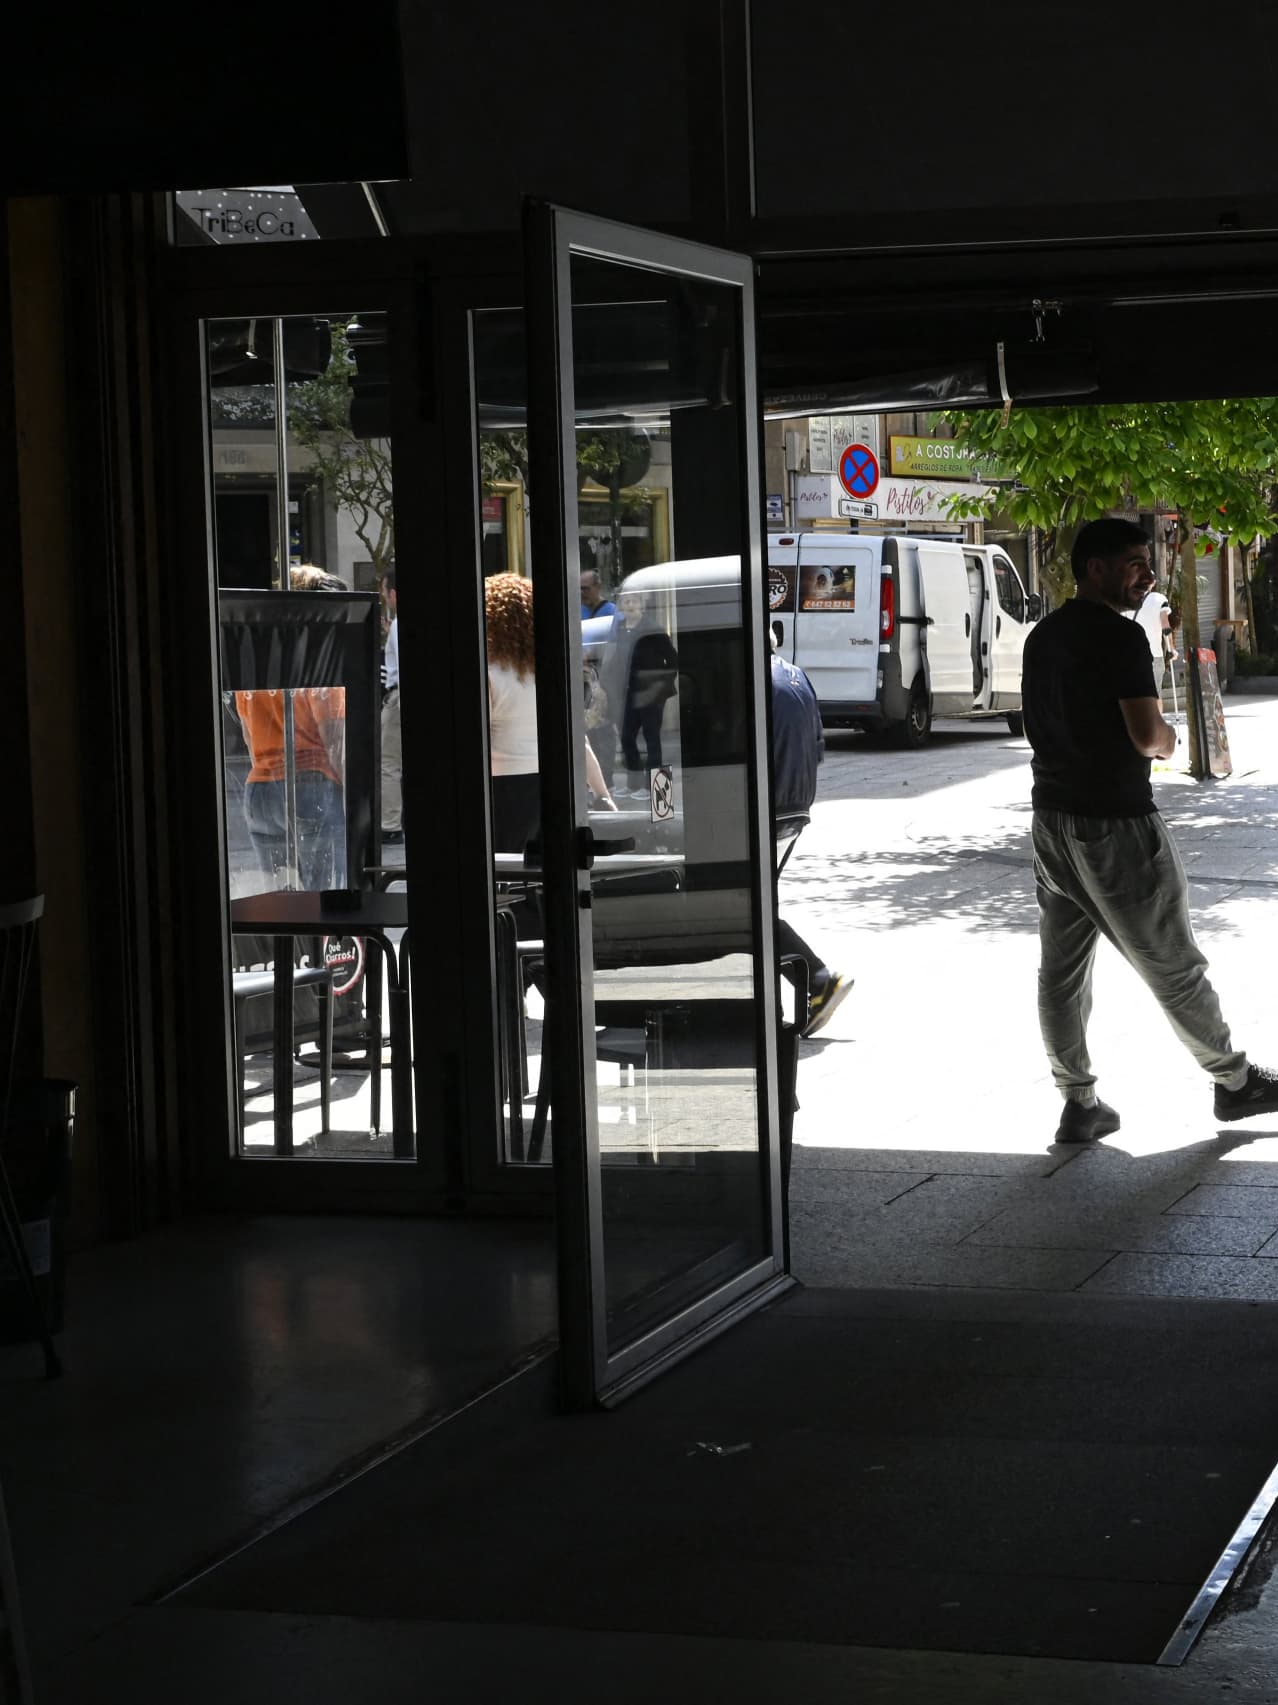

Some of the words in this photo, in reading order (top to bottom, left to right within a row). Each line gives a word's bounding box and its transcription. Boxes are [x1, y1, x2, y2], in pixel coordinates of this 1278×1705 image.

[191, 207, 294, 236] TriBeCa
[916, 444, 923, 457] A
[886, 486, 924, 515] Pistilos
